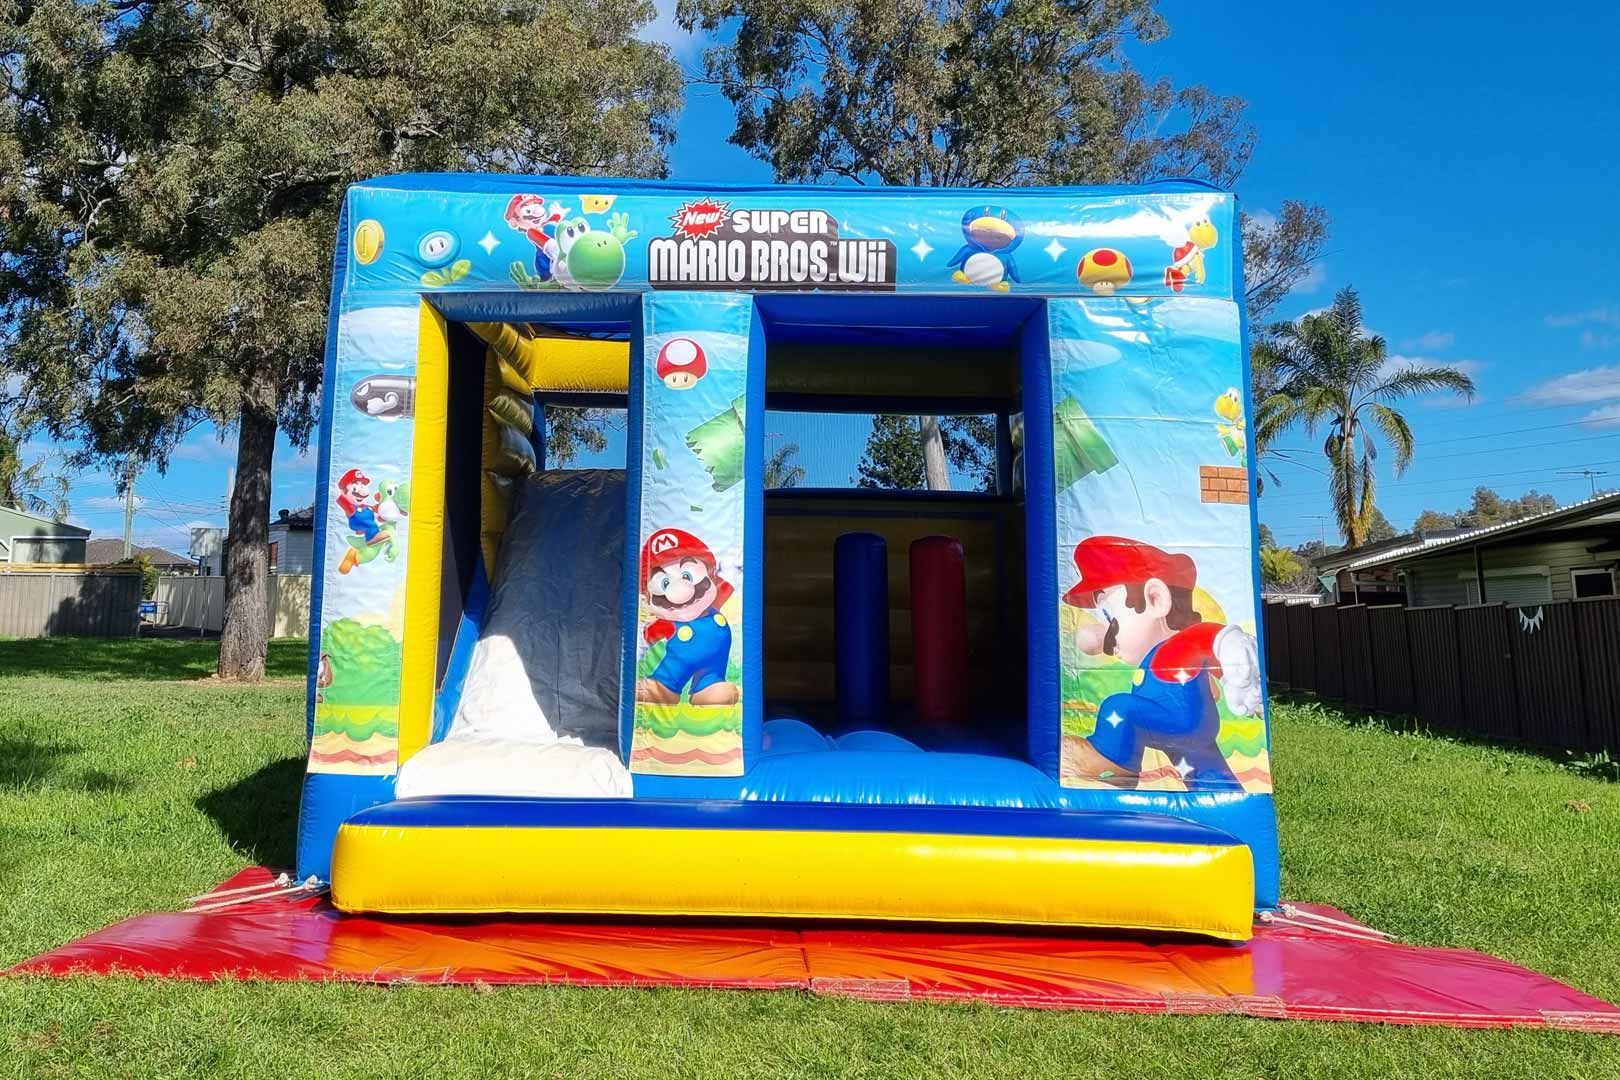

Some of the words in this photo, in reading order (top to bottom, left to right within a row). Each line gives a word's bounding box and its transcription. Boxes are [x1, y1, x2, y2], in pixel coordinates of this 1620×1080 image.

[682, 211, 721, 225] New
[732, 210, 828, 234] SUPER
[650, 239, 746, 281] MARIO
[838, 240, 887, 283] Wii
[655, 535, 676, 552] M
